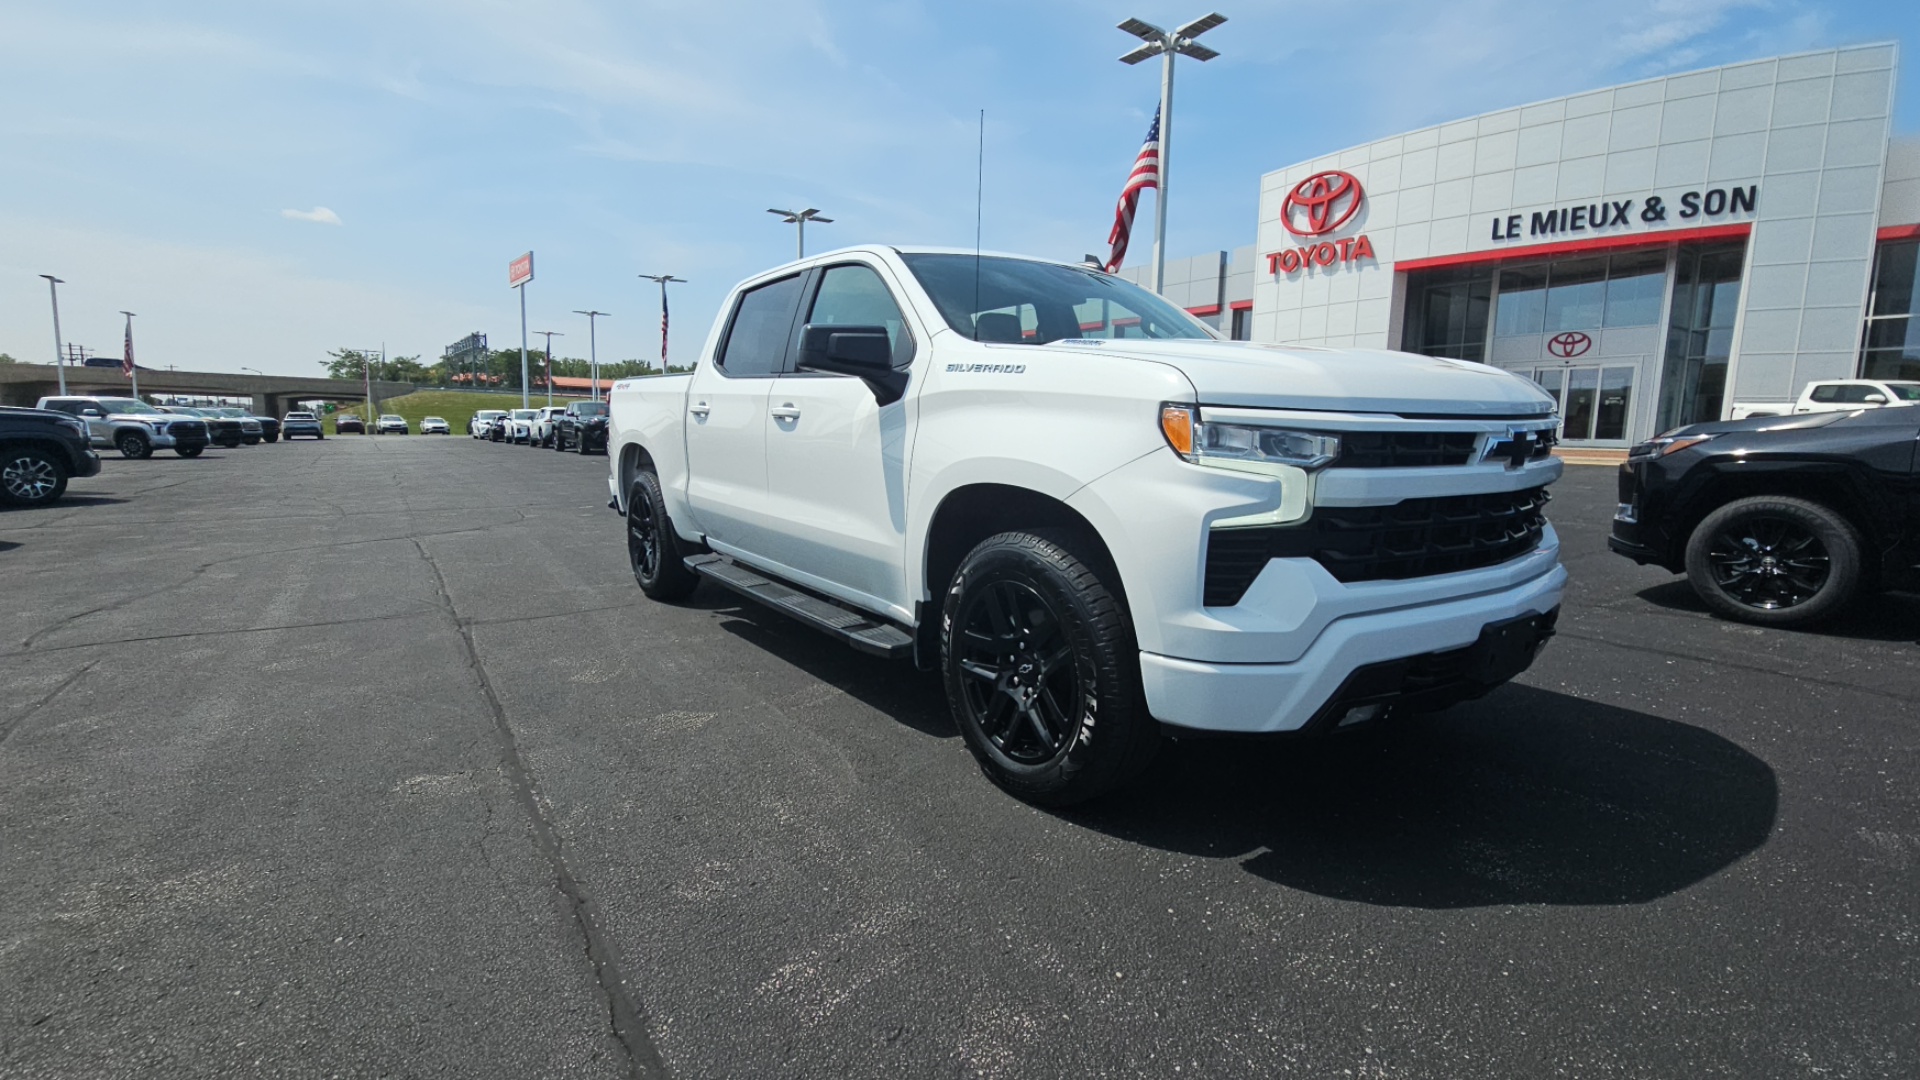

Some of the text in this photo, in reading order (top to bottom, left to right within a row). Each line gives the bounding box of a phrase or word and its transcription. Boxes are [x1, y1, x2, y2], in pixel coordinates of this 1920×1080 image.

[1491, 185, 1757, 240] LE MIEUX & SON
[1266, 235, 1374, 275] TOYOTA
[946, 363, 1026, 374] SILVERADO
